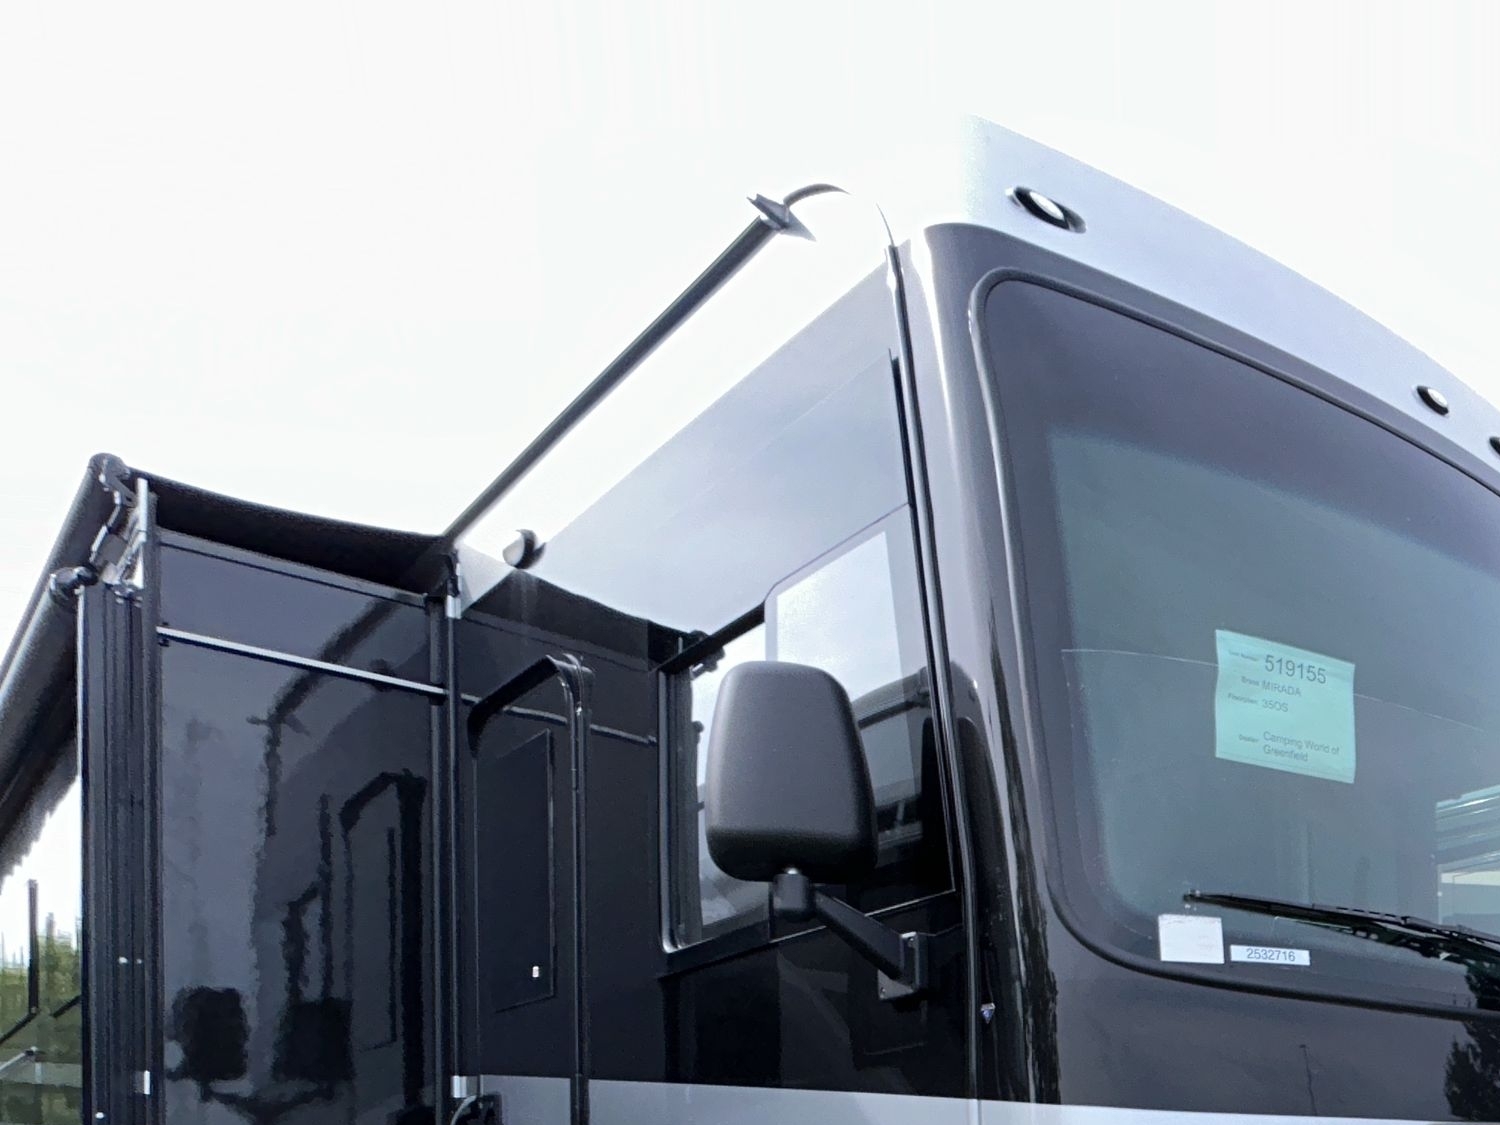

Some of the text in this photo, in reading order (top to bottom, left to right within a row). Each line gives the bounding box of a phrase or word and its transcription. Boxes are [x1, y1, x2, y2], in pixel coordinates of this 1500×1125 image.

[1265, 654, 1327, 684] 519155
[1262, 680, 1302, 696] MIRADA
[1263, 731, 1303, 748] Camping
[1305, 739, 1330, 755] World
[1331, 746, 1340, 755] of
[1263, 745, 1308, 761] Greenfield
[1246, 948, 1296, 961] 2532716
